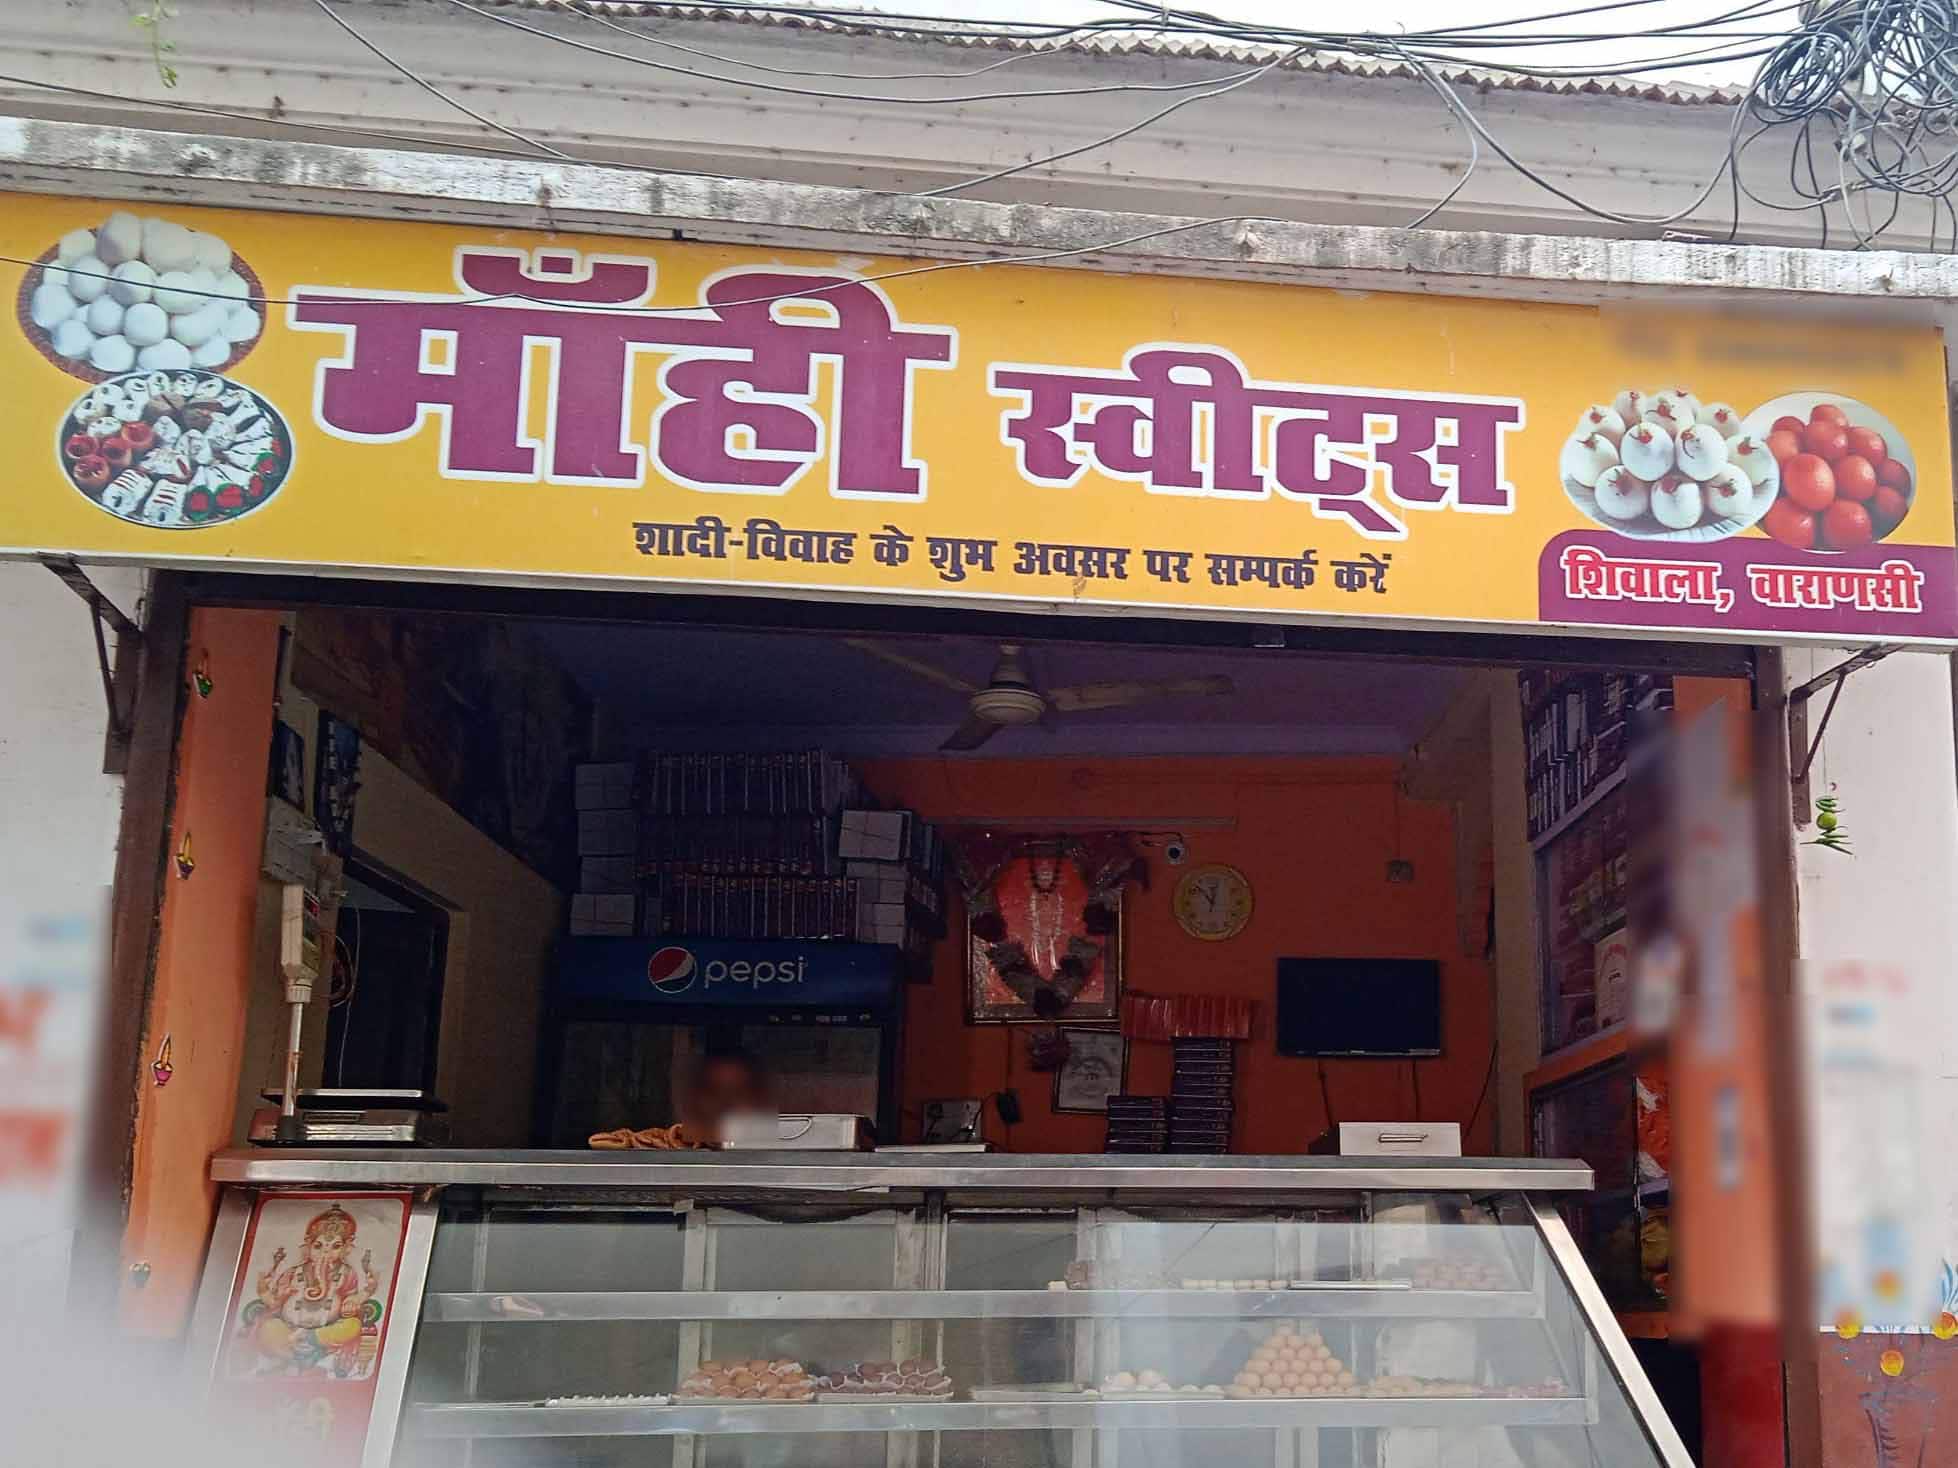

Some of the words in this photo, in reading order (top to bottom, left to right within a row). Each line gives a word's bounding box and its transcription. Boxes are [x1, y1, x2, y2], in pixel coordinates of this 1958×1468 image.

[988, 342, 1524, 539] स्वीट्स
[632, 515, 857, 564] शादी-विवाह
[869, 524, 914, 566] के
[1014, 542, 1130, 580] अवसर
[1143, 549, 1193, 582] पर
[1203, 550, 1319, 589] सम्पर्क
[1329, 552, 1392, 593] करें
[1560, 546, 1735, 613] शिवाला,
[1747, 561, 1925, 612] वाराणसी
[703, 956, 805, 989] pepsi
